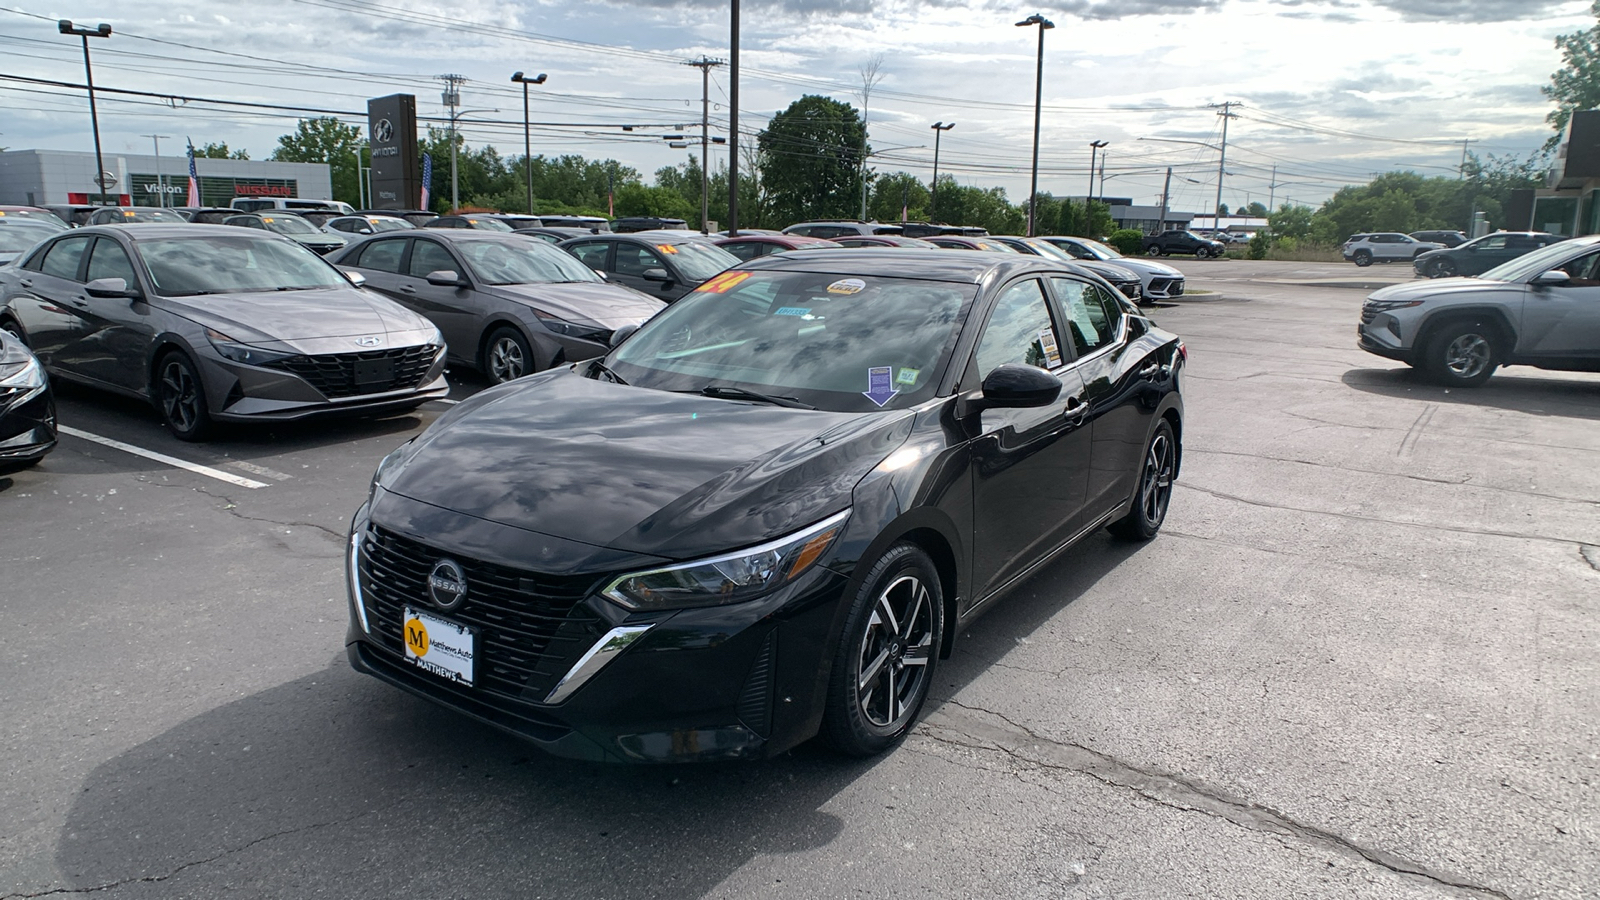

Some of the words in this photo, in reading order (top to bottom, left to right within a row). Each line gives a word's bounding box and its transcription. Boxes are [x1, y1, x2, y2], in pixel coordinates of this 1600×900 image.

[144, 183, 182, 194] Vision
[235, 185, 292, 196] NISSAN
[695, 271, 749, 293] 24
[430, 576, 465, 594] NISSAN
[408, 626, 425, 650] M
[429, 637, 457, 655] Matthews
[457, 647, 473, 660] Auto
[416, 659, 456, 682] MATTHEWS
